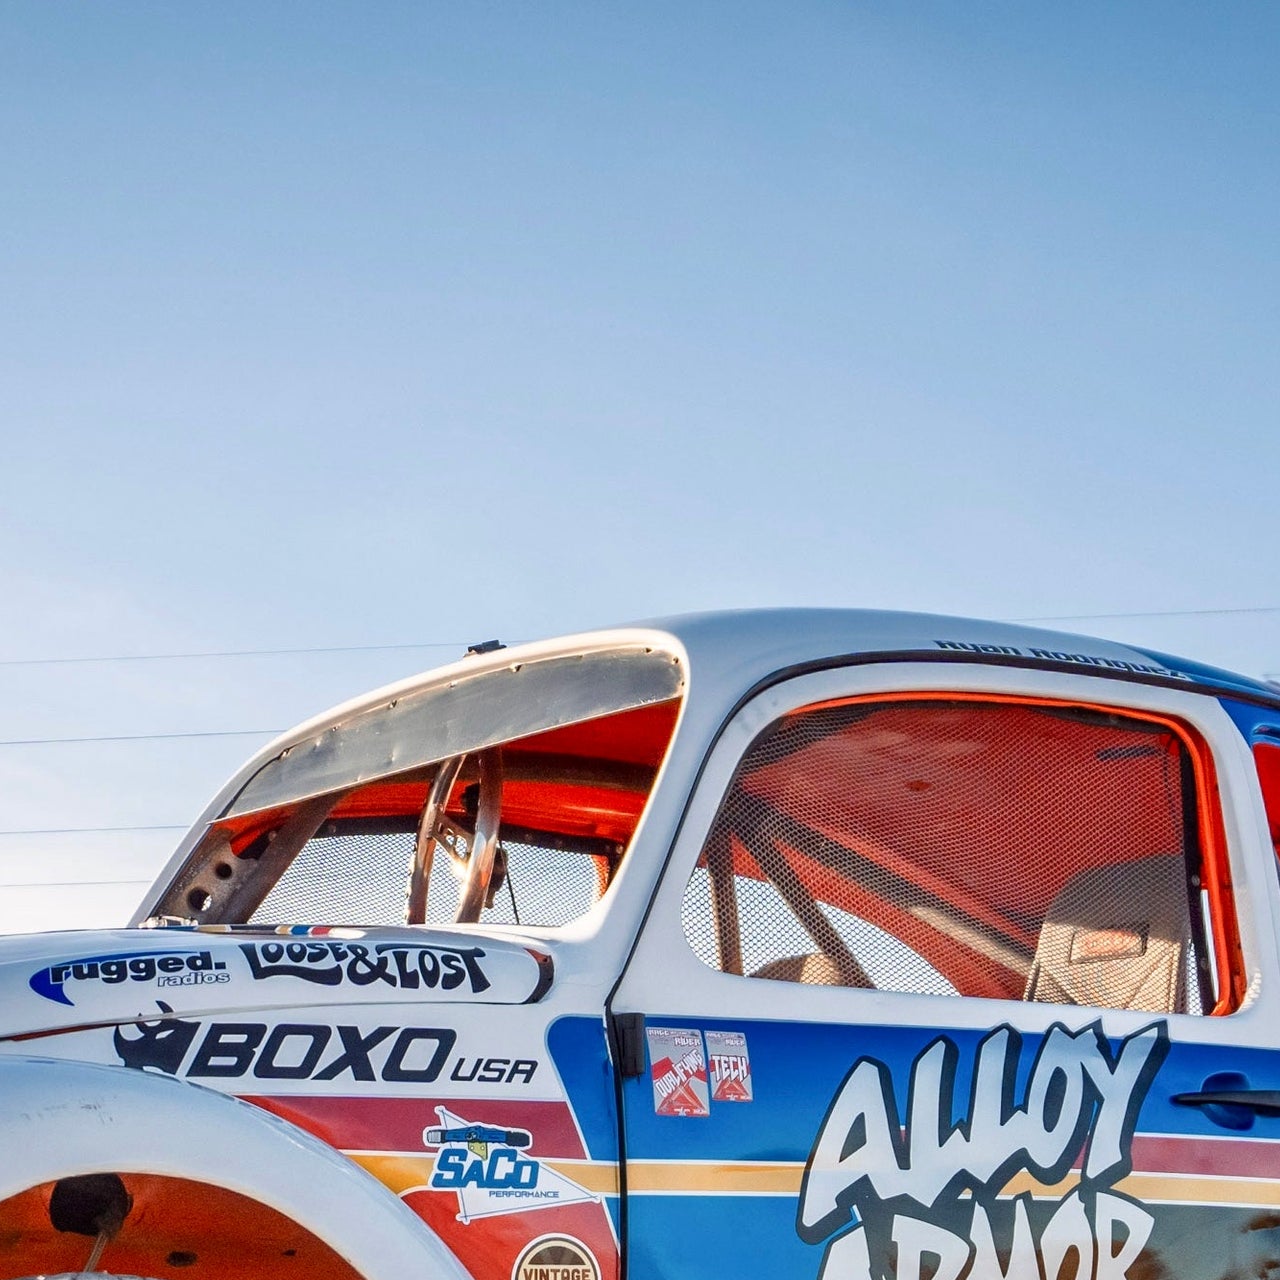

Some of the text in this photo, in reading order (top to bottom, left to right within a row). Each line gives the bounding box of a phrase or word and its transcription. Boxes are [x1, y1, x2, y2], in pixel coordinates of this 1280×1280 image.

[157, 972, 231, 987] radios
[186, 1022, 539, 1084] BOXO USA
[711, 1054, 748, 1082] TECH
[655, 1048, 704, 1099] QUALIFYING
[800, 1022, 1166, 1232] ALLOY
[489, 1190, 560, 1198] PERFORMANCE
